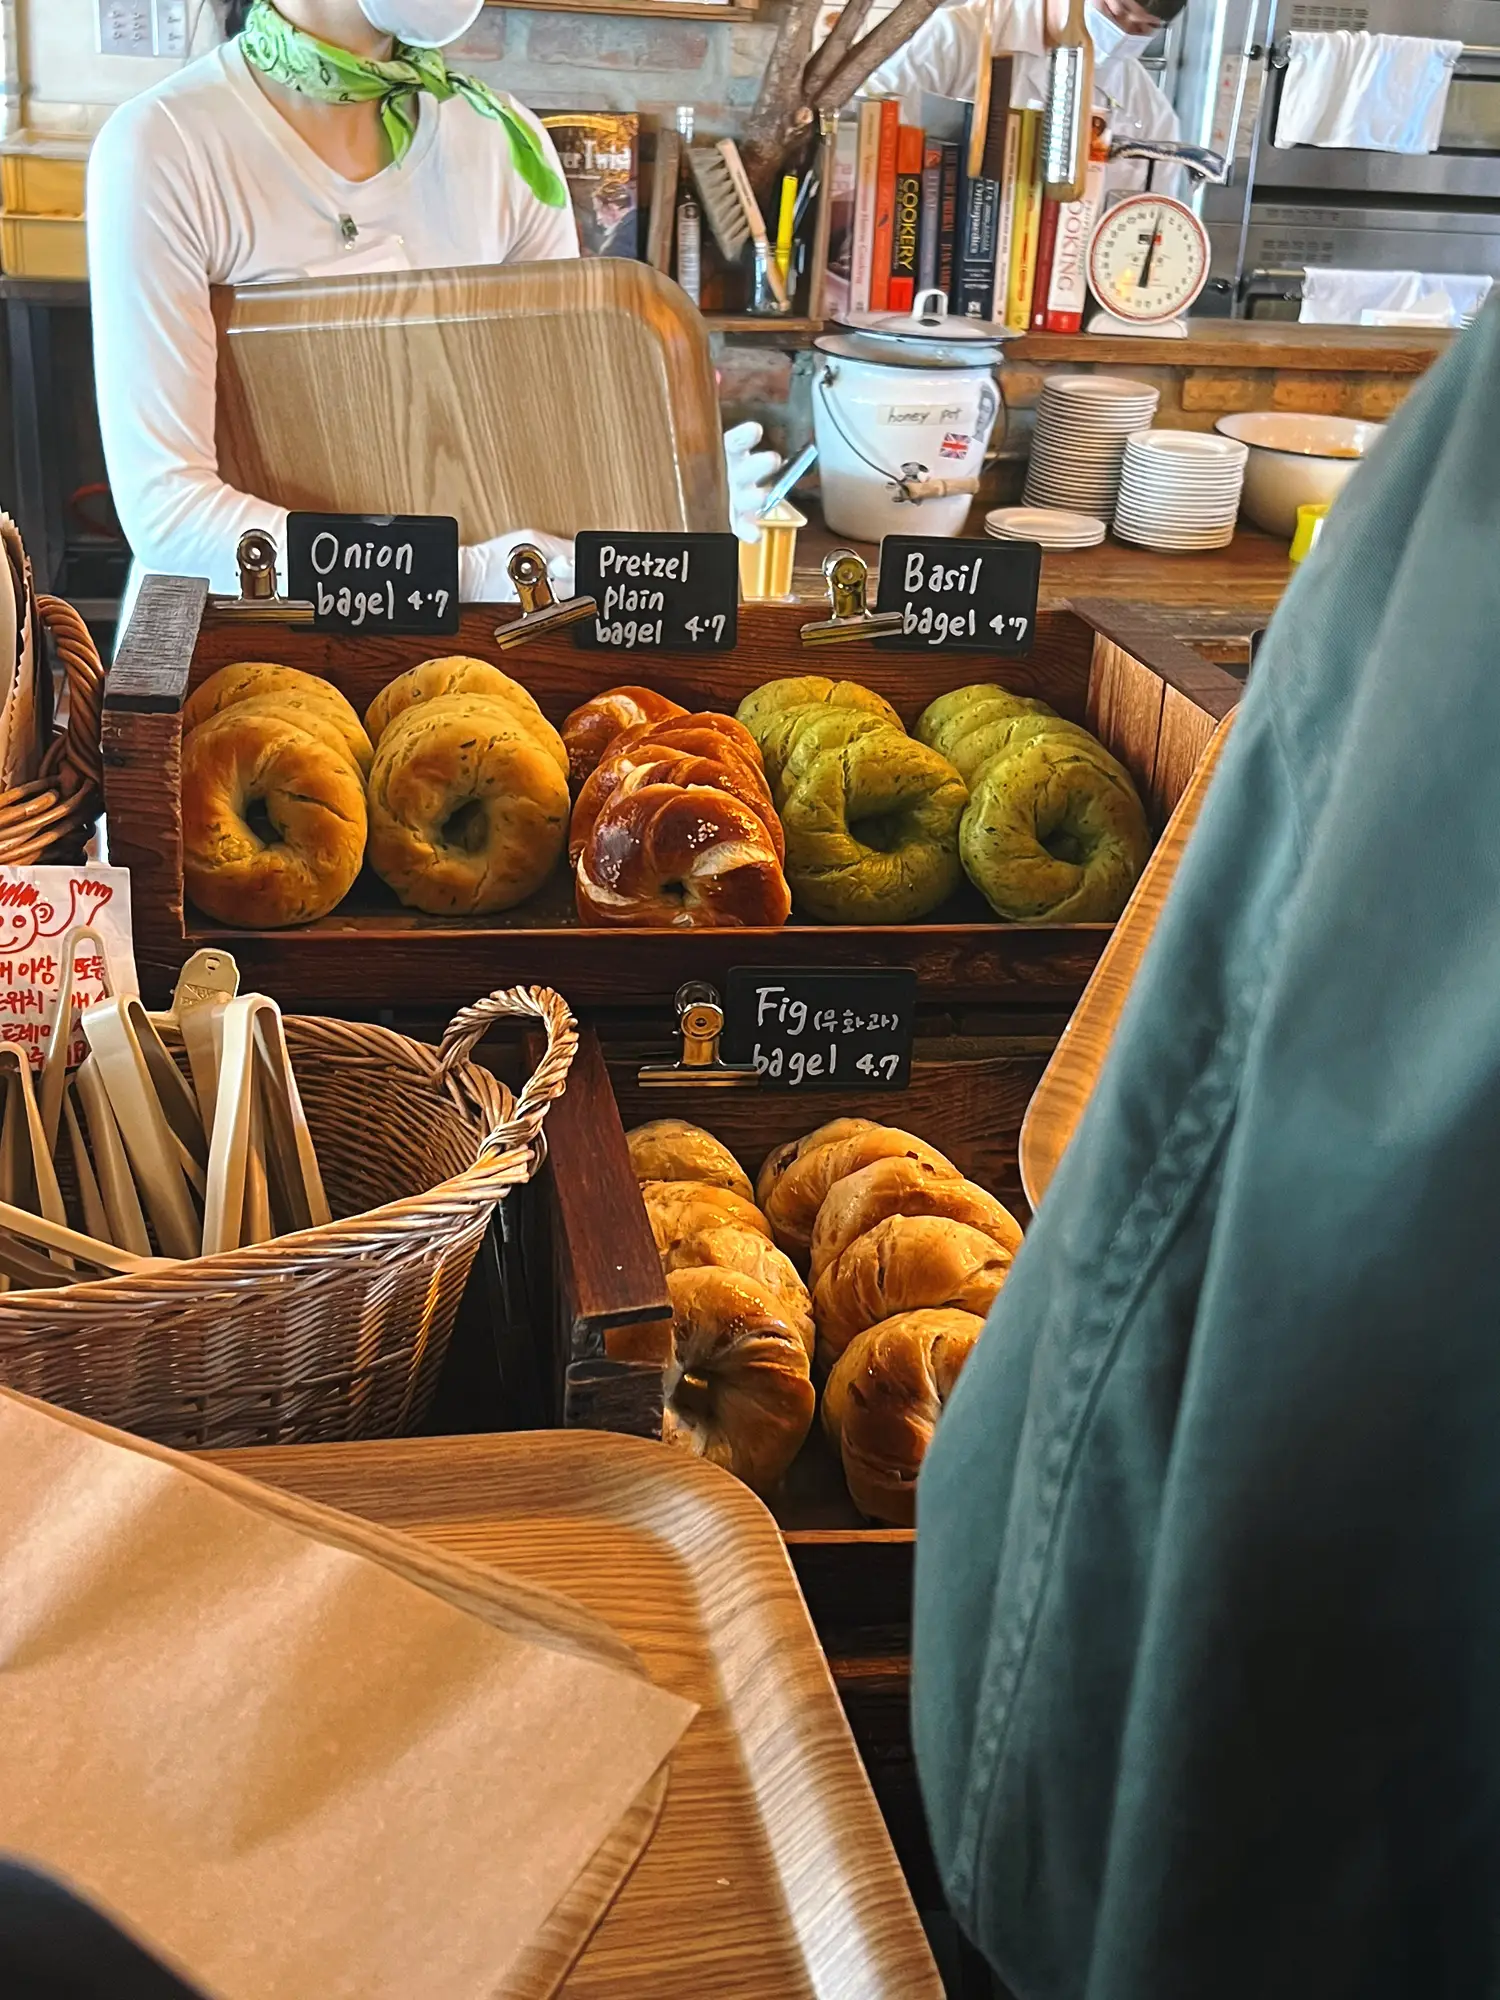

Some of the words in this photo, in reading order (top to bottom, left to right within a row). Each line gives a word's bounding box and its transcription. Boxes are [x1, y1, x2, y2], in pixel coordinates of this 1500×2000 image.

[899, 178, 919, 271] COOKERY
[1056, 200, 1084, 292] OOKING
[887, 406, 931, 425] honey
[940, 407, 963, 424] pot
[311, 531, 413, 575] Onion
[600, 545, 689, 583] Pretzel
[904, 552, 983, 595] Basil
[317, 580, 395, 626] bagel
[604, 583, 664, 621] plain
[902, 601, 976, 645] bagel
[595, 617, 663, 649] bagel
[18, 955, 58, 985] 이상
[755, 986, 808, 1036] Fig
[752, 1043, 837, 1086] bagel
[855, 1053, 900, 1081] 4.7
